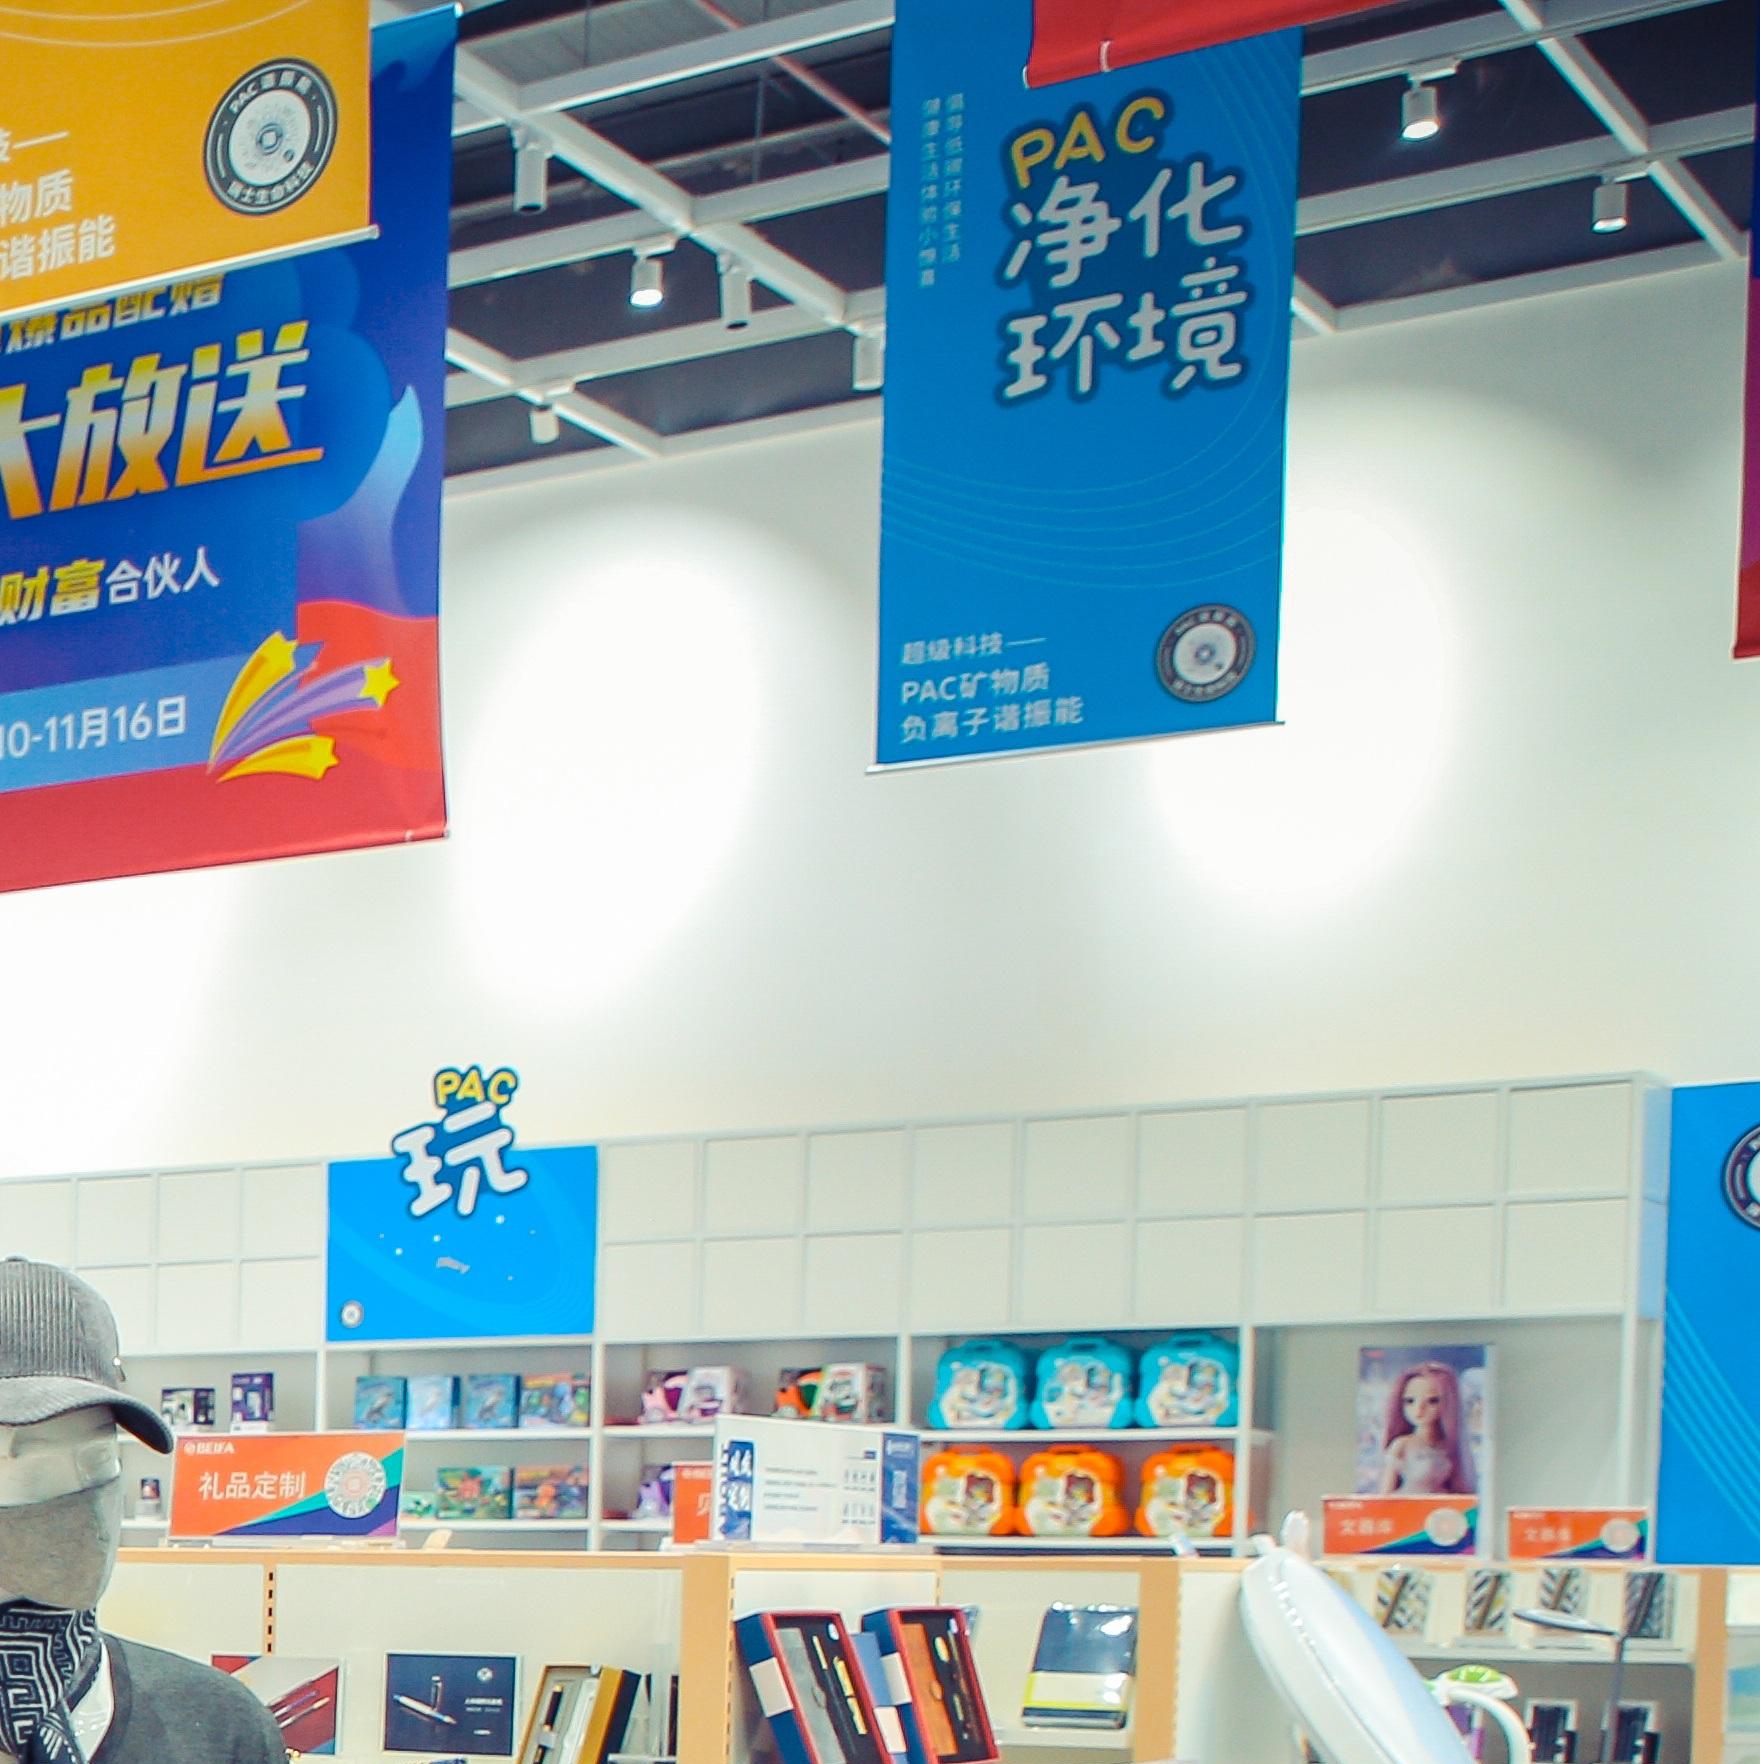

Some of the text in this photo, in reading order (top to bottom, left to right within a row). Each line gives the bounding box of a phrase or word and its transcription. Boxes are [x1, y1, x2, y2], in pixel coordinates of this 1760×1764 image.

[1011, 97, 1166, 188] PAC
[1003, 162, 1247, 286] 净化
[1003, 257, 1248, 400] 环境
[901, 661, 1050, 705] PAC矿物质
[900, 695, 1085, 744] 负离子谐振能
[434, 1067, 519, 1106] PAC
[393, 1100, 528, 1219] 玩
[198, 1471, 307, 1501] 礼品定制
